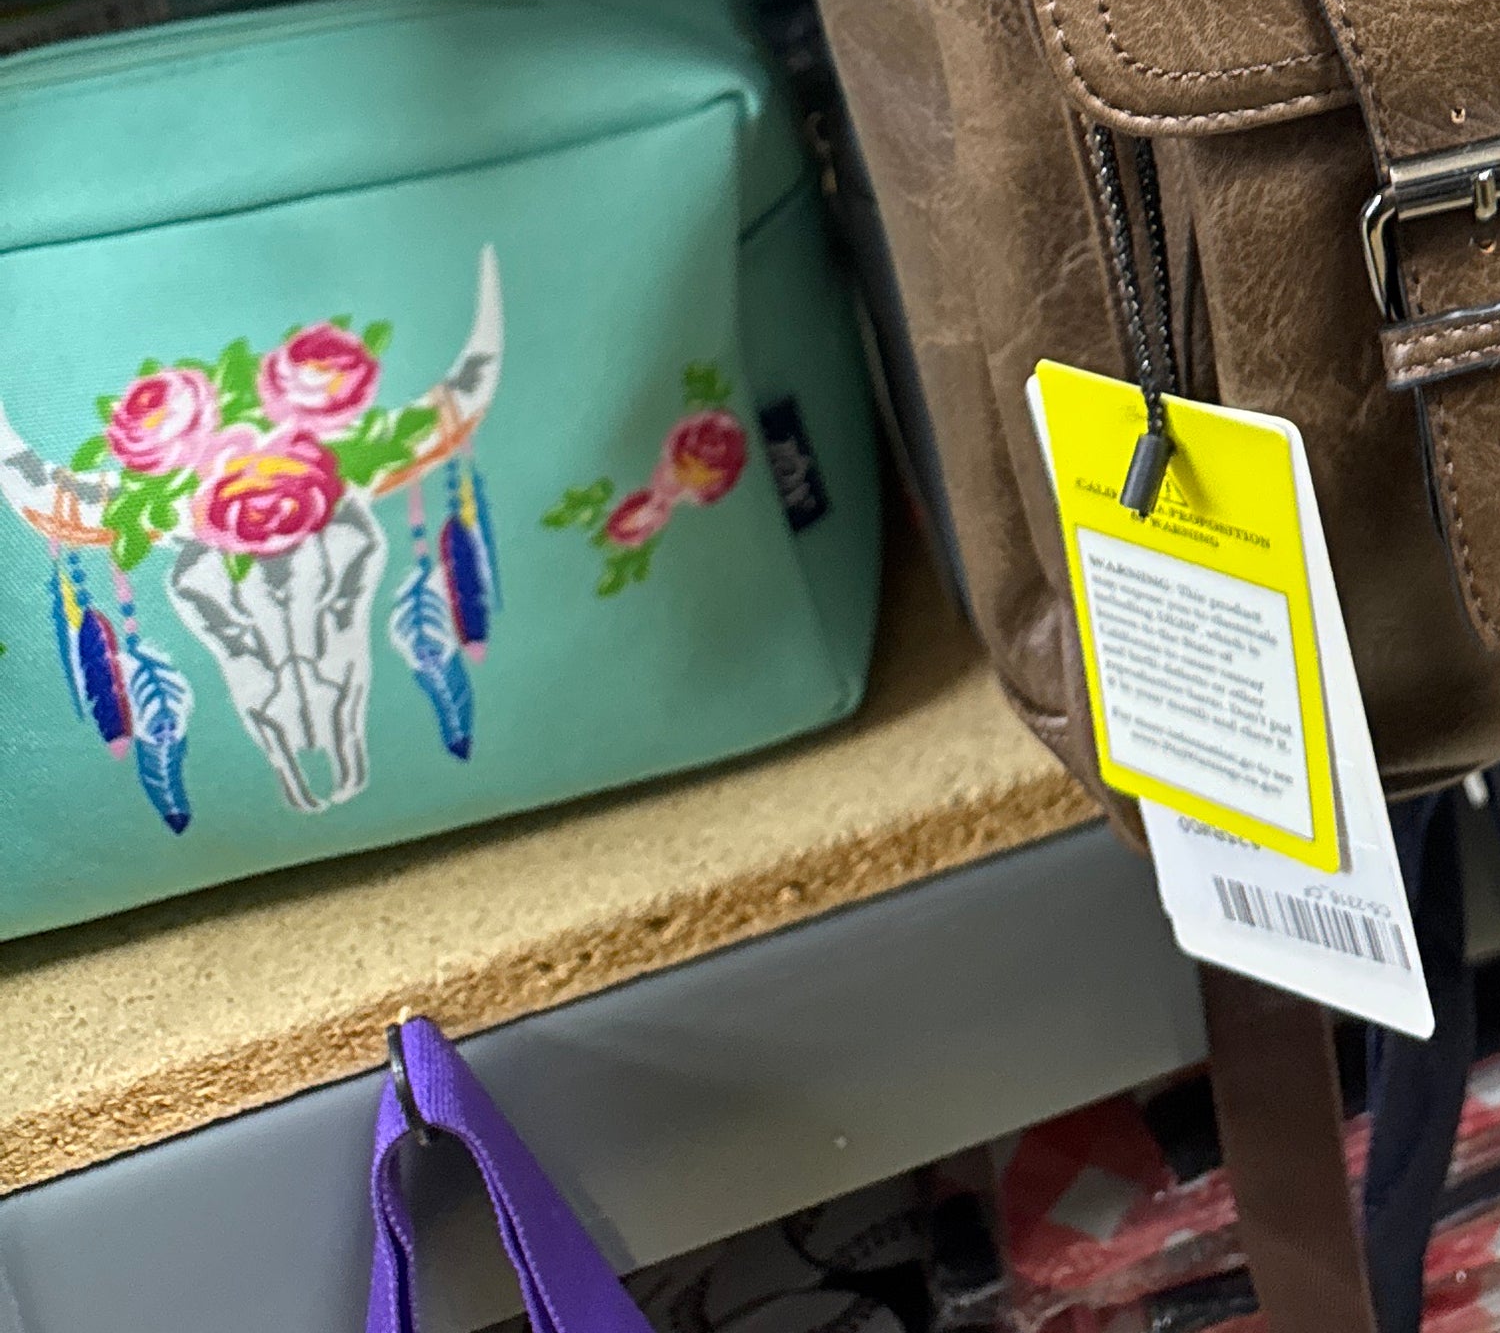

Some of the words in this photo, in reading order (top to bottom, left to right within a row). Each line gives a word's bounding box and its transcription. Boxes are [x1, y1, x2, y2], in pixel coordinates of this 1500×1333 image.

[1151, 517, 1220, 548] WARNING
[1169, 506, 1271, 549] PROPOSITION
[1209, 597, 1262, 623] product
